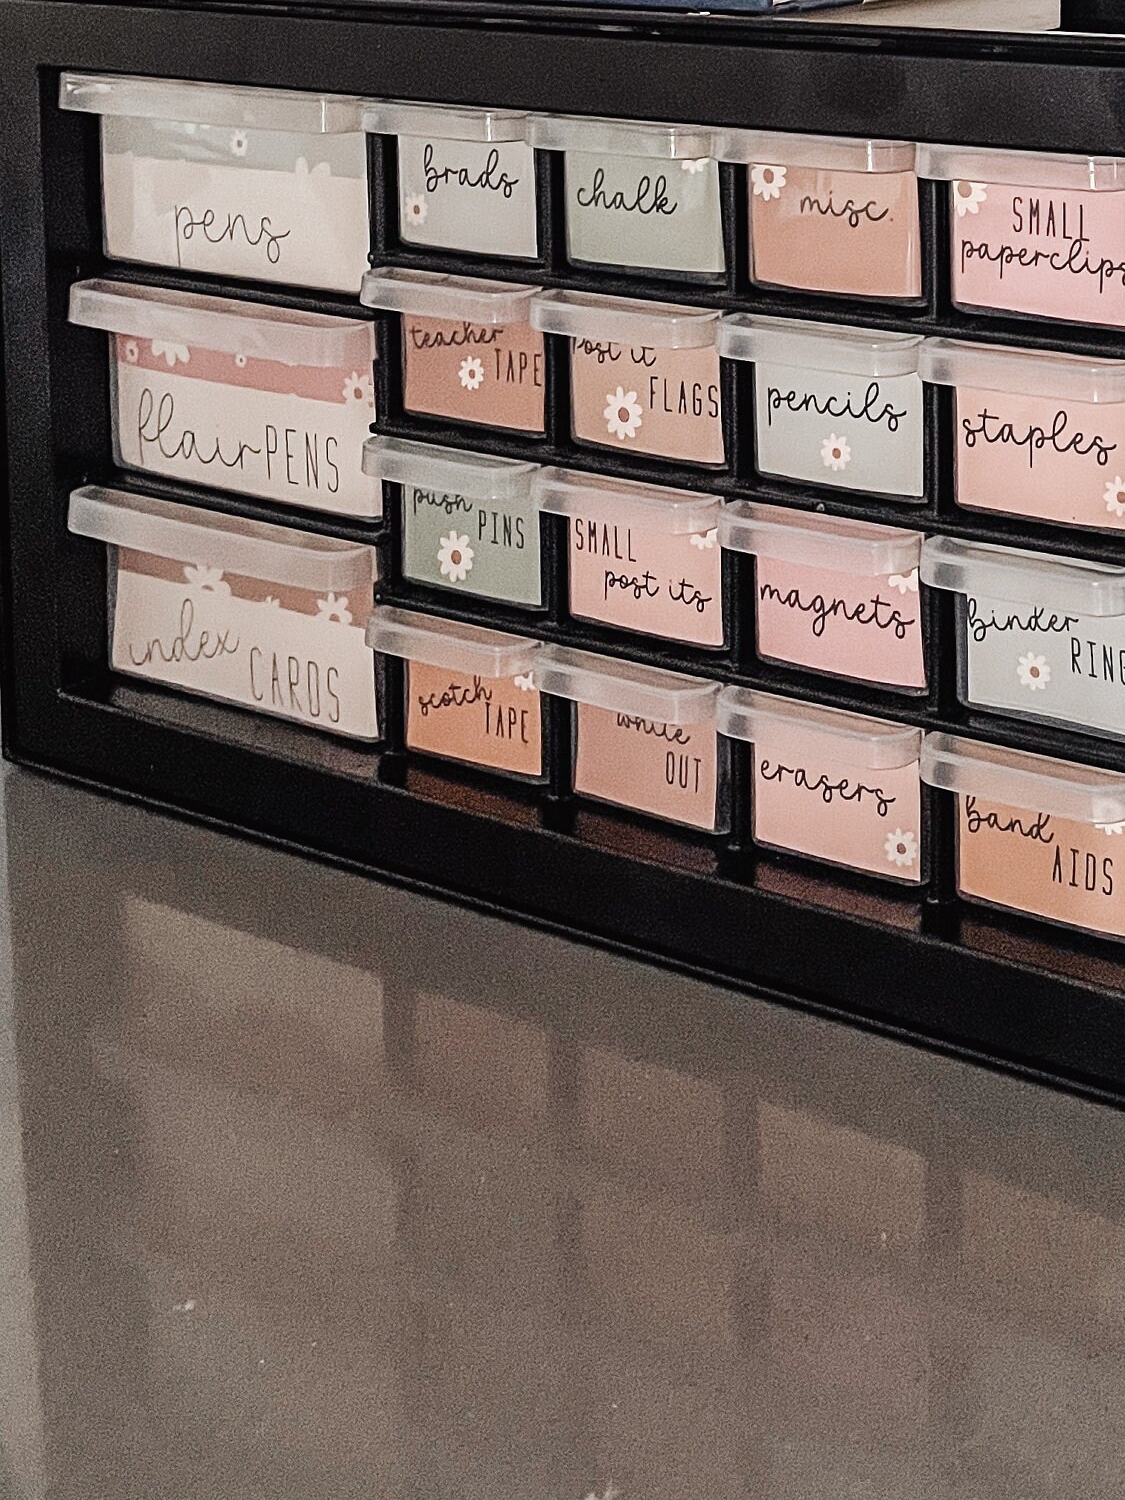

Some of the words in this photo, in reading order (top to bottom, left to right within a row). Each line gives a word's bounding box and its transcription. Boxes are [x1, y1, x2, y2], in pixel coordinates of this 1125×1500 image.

[423, 144, 519, 198] brads
[577, 168, 677, 215] chalk
[800, 189, 894, 228] misc.
[1012, 196, 1090, 242] SMALL
[174, 203, 290, 267] pens
[410, 321, 504, 349] teacher
[631, 346, 657, 367] it
[494, 347, 542, 387] TAPE
[650, 376, 719, 418] FLAGS
[767, 382, 907, 432] pencils
[962, 408, 1117, 468] staples
[478, 509, 524, 549] PINS
[575, 518, 637, 563] SMALL
[605, 570, 660, 601] post
[669, 578, 713, 613] its
[760, 583, 915, 639] magnets
[129, 598, 240, 666] index
[968, 597, 1079, 642] binder
[250, 646, 340, 723] CARDS
[418, 675, 492, 717] scotch
[485, 701, 529, 744] TAPE
[666, 751, 701, 793] OUT
[761, 759, 896, 817] erasers
[966, 795, 1055, 843] band
[1052, 844, 1113, 896] AIDS
